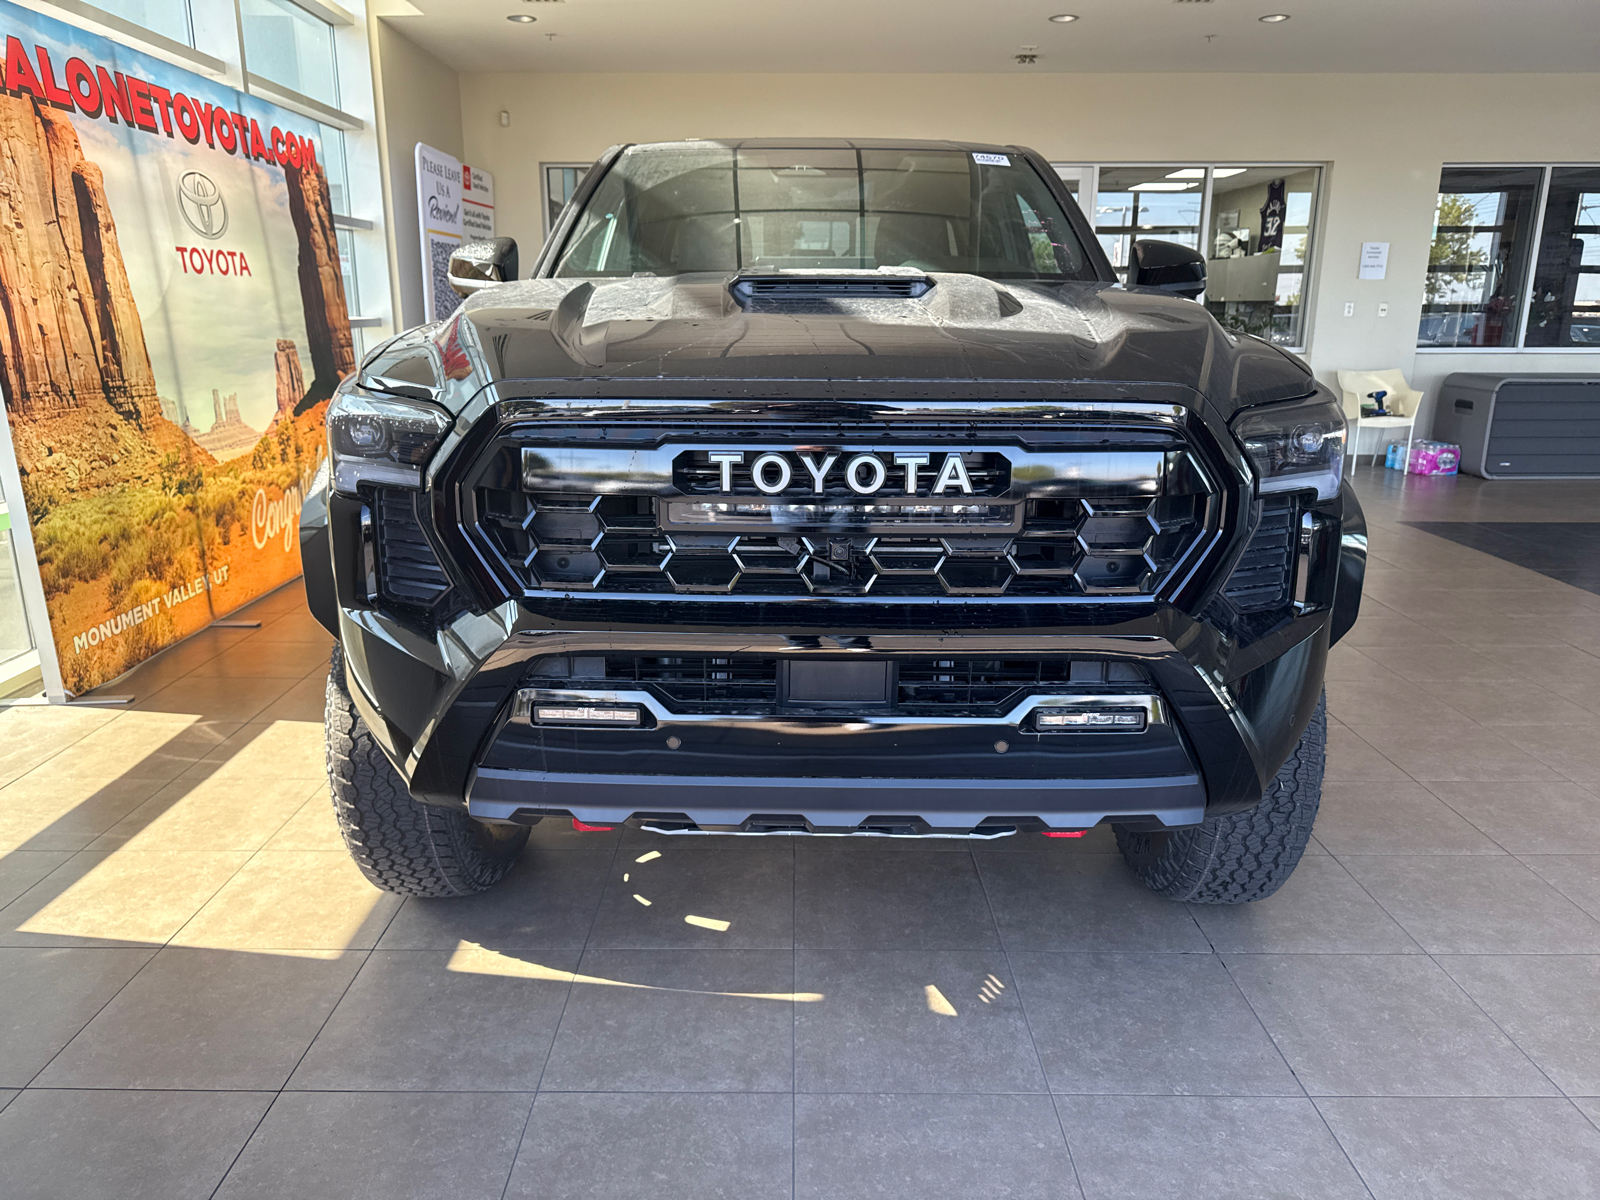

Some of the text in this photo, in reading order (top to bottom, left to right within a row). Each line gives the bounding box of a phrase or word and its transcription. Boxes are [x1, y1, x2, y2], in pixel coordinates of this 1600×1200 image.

[0, 34, 321, 174] ALONETOYOTA.COM
[422, 156, 444, 178] PLEASE
[444, 165, 461, 184] LEAVE
[436, 181, 451, 199] US A
[1264, 216, 1280, 236] 32
[175, 245, 252, 278] TOYOTA
[708, 451, 975, 496] TOYOTA
[72, 564, 230, 655] MONUMENT VALLEY, UT
